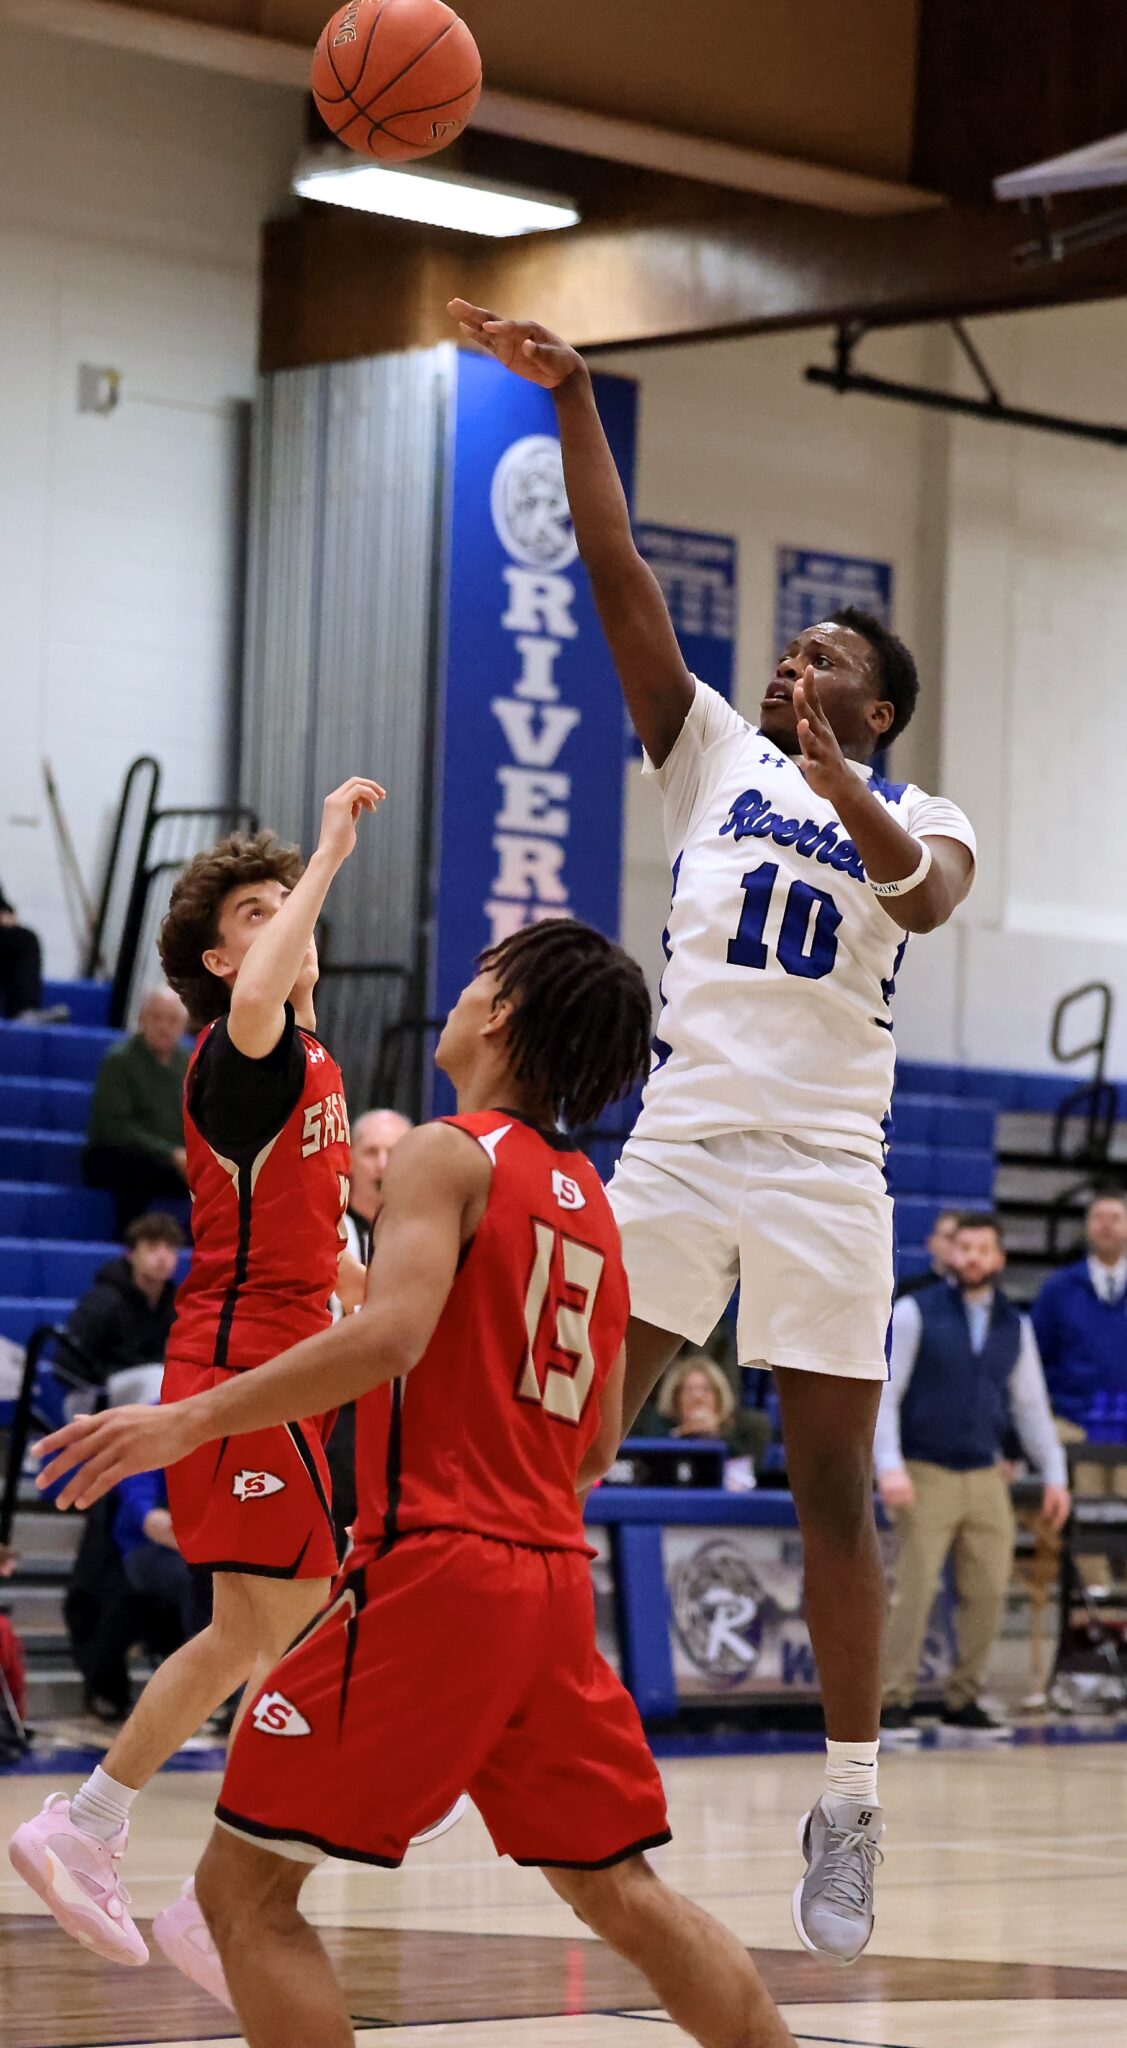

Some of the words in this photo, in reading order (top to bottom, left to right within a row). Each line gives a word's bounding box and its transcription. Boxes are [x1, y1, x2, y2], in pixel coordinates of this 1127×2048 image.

[727, 861, 843, 980] 10
[560, 1179, 576, 1205] S
[514, 1216, 605, 1427] 13
[244, 1474, 265, 1496] S
[700, 1586, 757, 1663] R
[261, 1703, 292, 1730] S
